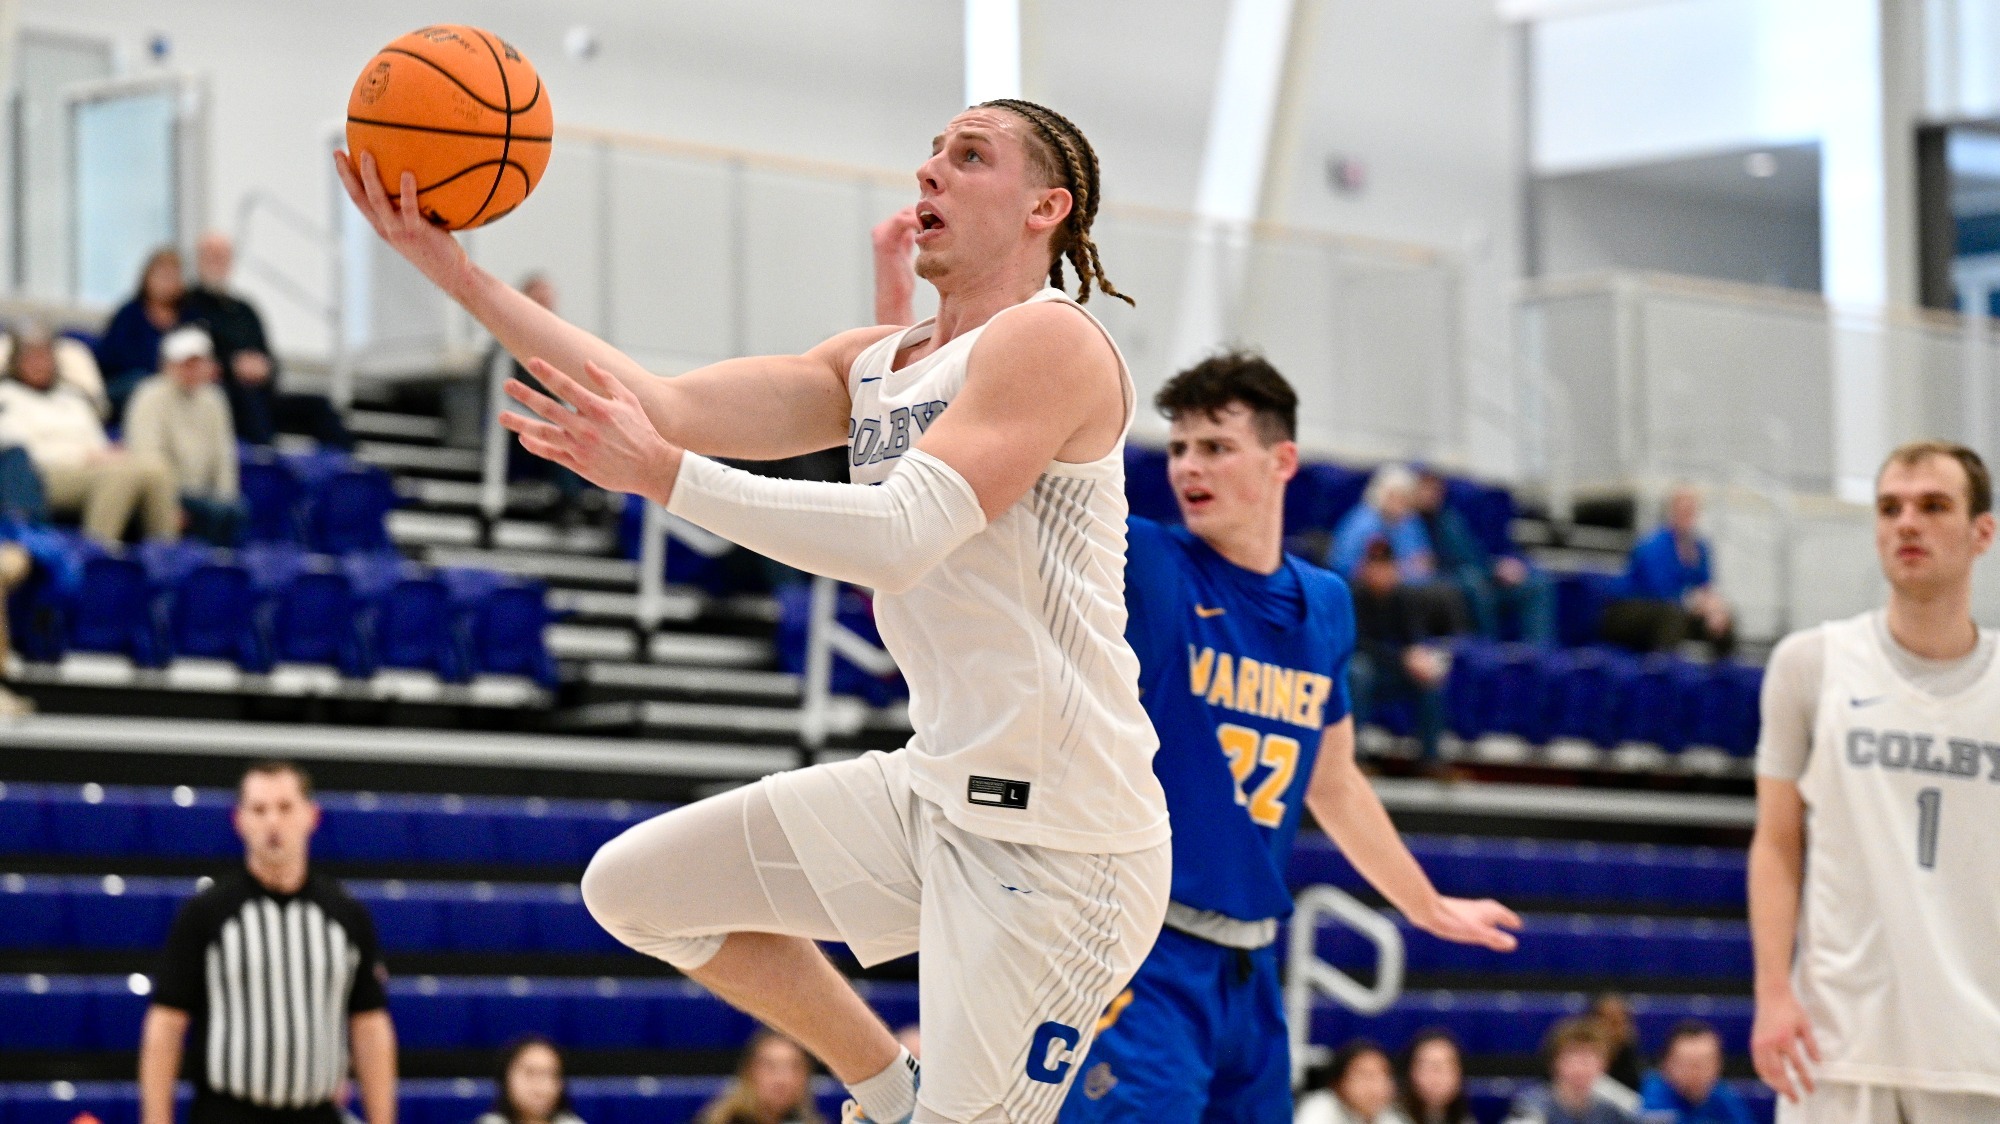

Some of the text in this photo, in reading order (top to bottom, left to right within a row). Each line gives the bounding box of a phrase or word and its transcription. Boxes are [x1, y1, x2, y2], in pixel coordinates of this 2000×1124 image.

[1010, 788, 1019, 801] L
[1216, 722, 1301, 829] 22
[1916, 787, 1941, 871] 1
[1026, 1021, 1080, 1085] C
